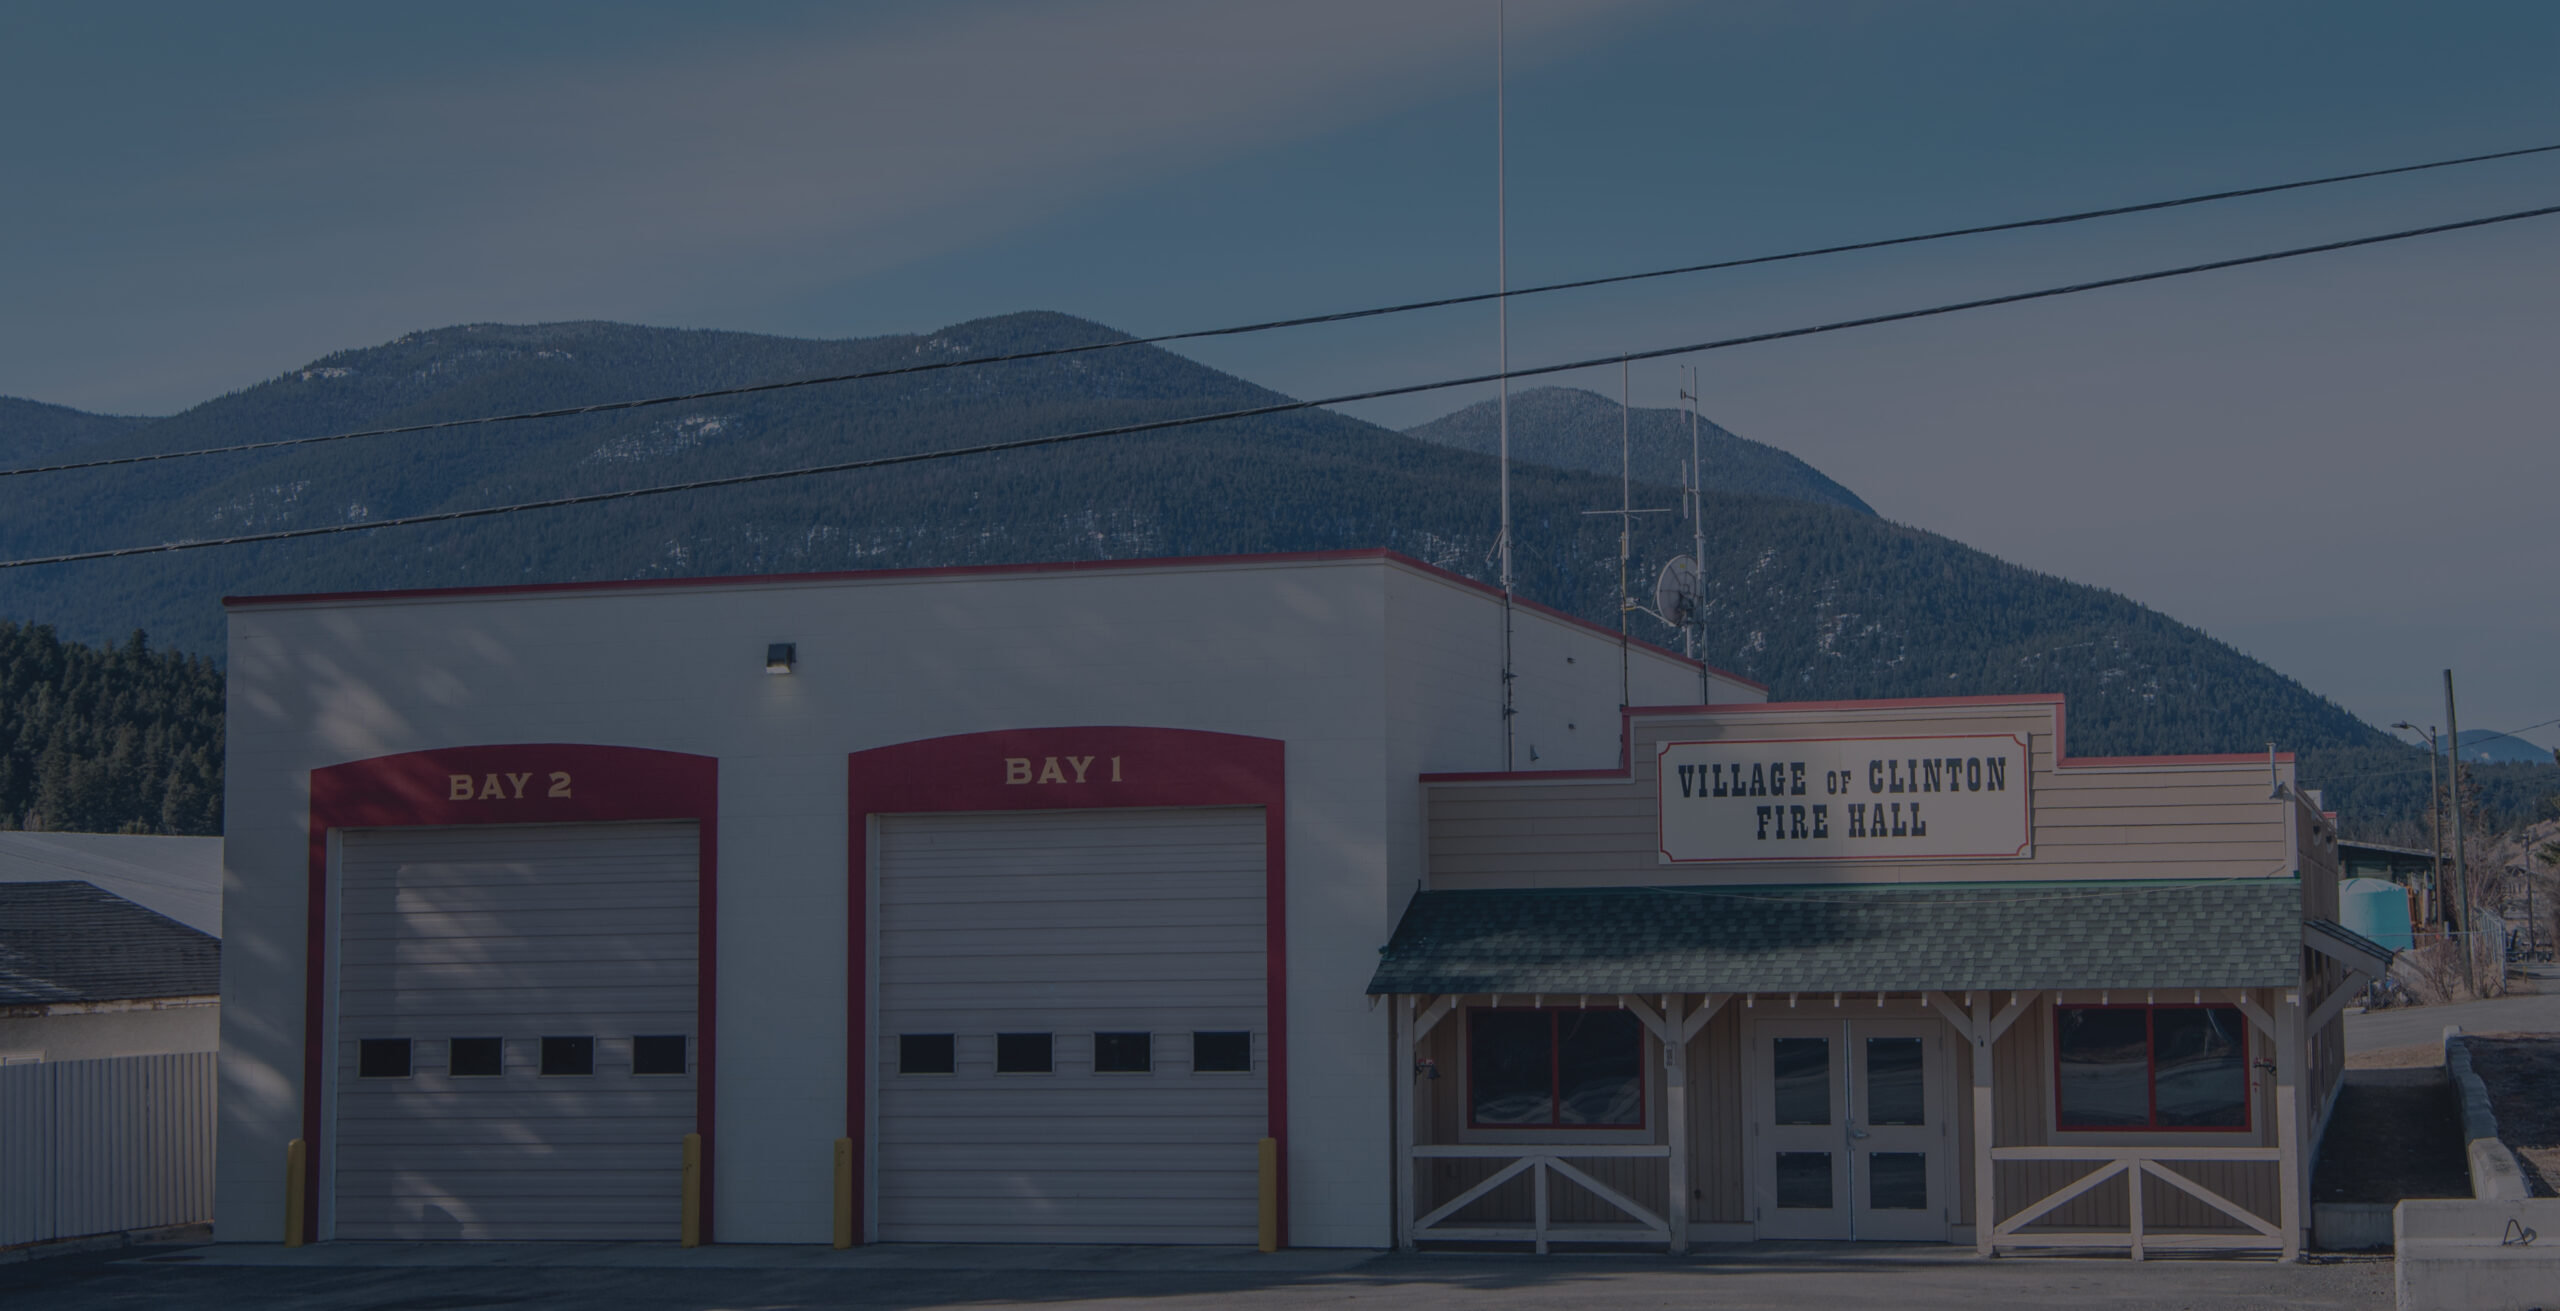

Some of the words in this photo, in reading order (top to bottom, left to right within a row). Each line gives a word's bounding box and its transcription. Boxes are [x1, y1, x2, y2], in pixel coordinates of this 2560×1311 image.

[448, 772, 533, 801] BAY
[548, 771, 571, 799] 2
[1004, 755, 1095, 785] BAY
[1111, 755, 1122, 782] 1
[1678, 762, 1806, 798] VILLAGE
[1827, 770, 1851, 795] OF
[1869, 757, 2006, 793] CLINTON
[1757, 805, 1829, 840] FIRE
[1848, 803, 1926, 838] HALL
